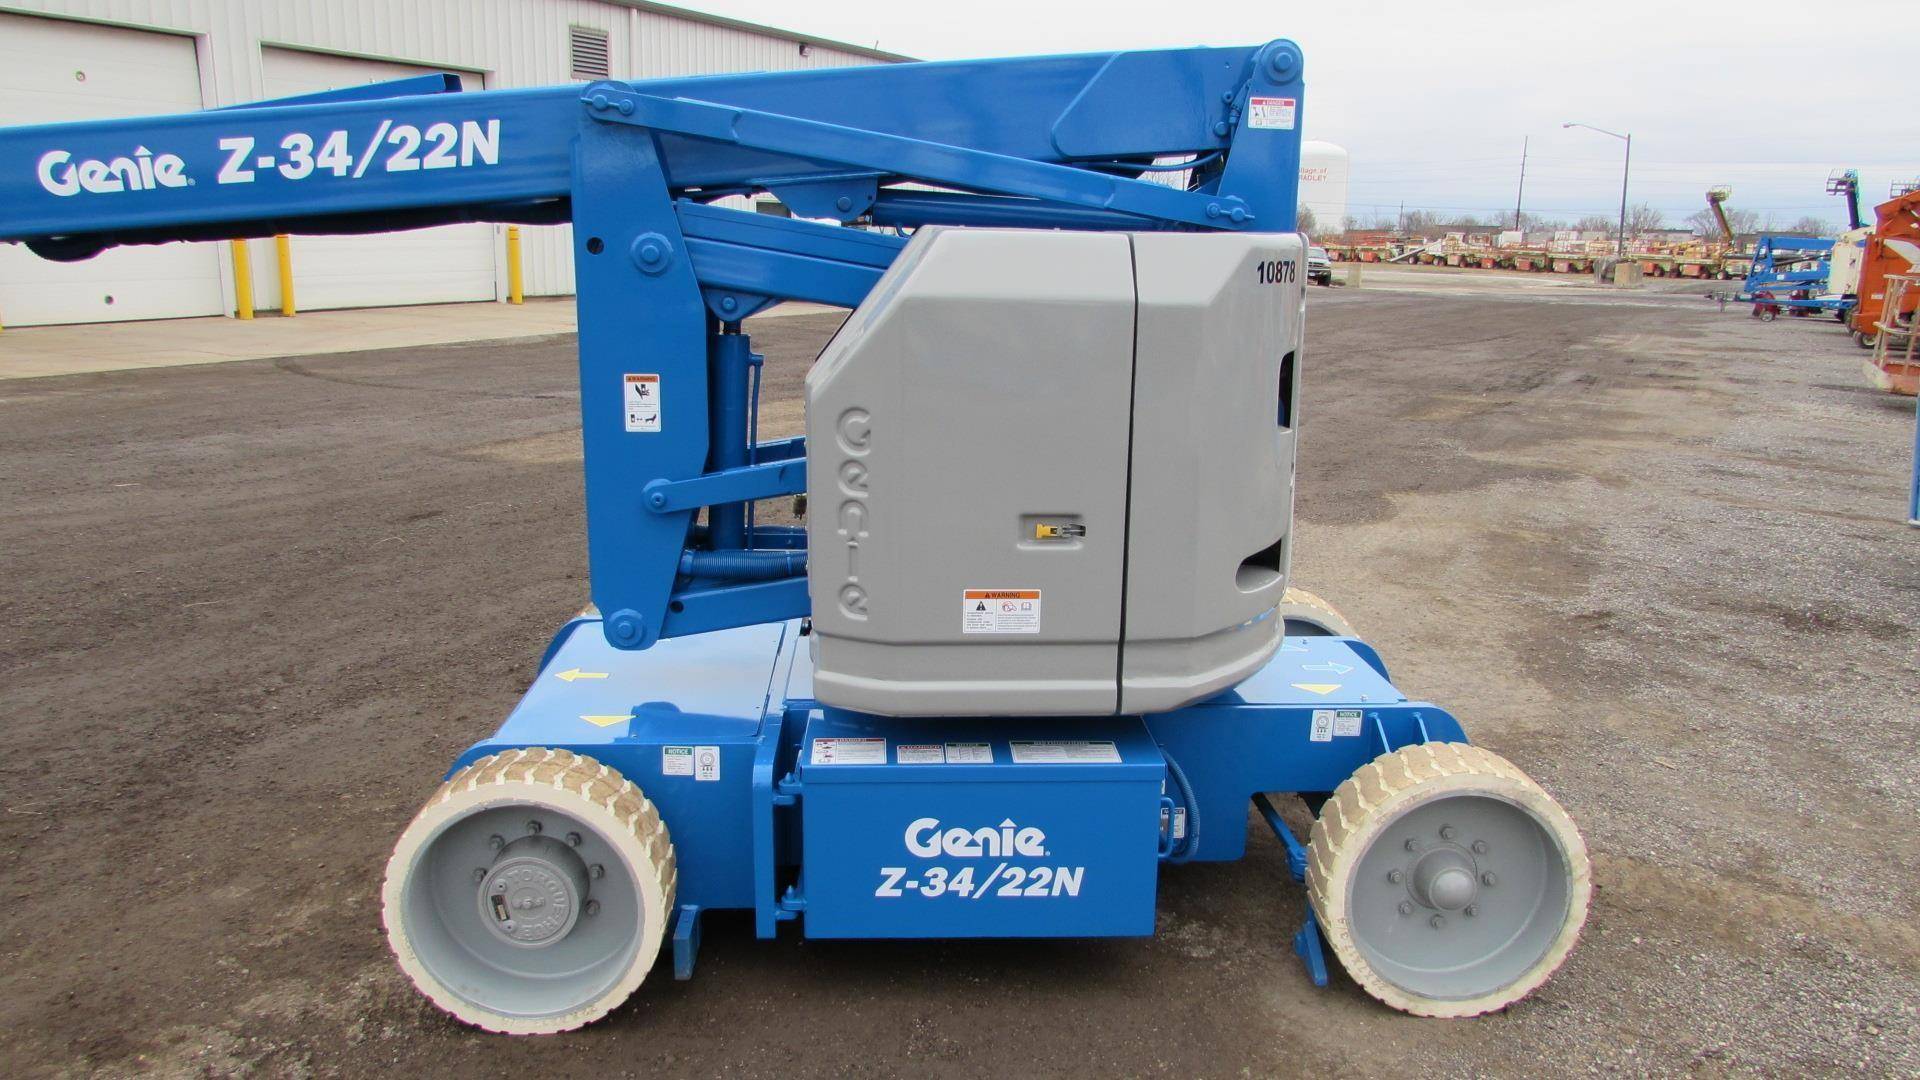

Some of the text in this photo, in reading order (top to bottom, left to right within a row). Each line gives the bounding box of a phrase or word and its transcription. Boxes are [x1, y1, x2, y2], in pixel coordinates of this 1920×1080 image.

[37, 119, 501, 197] Genie Z-34/22N
[1257, 260, 1296, 285] 10878
[836, 406, 872, 622] Genie
[991, 591, 1021, 599] WARNING
[904, 817, 1047, 858] Genie
[875, 863, 1084, 899] Z-34/22N
